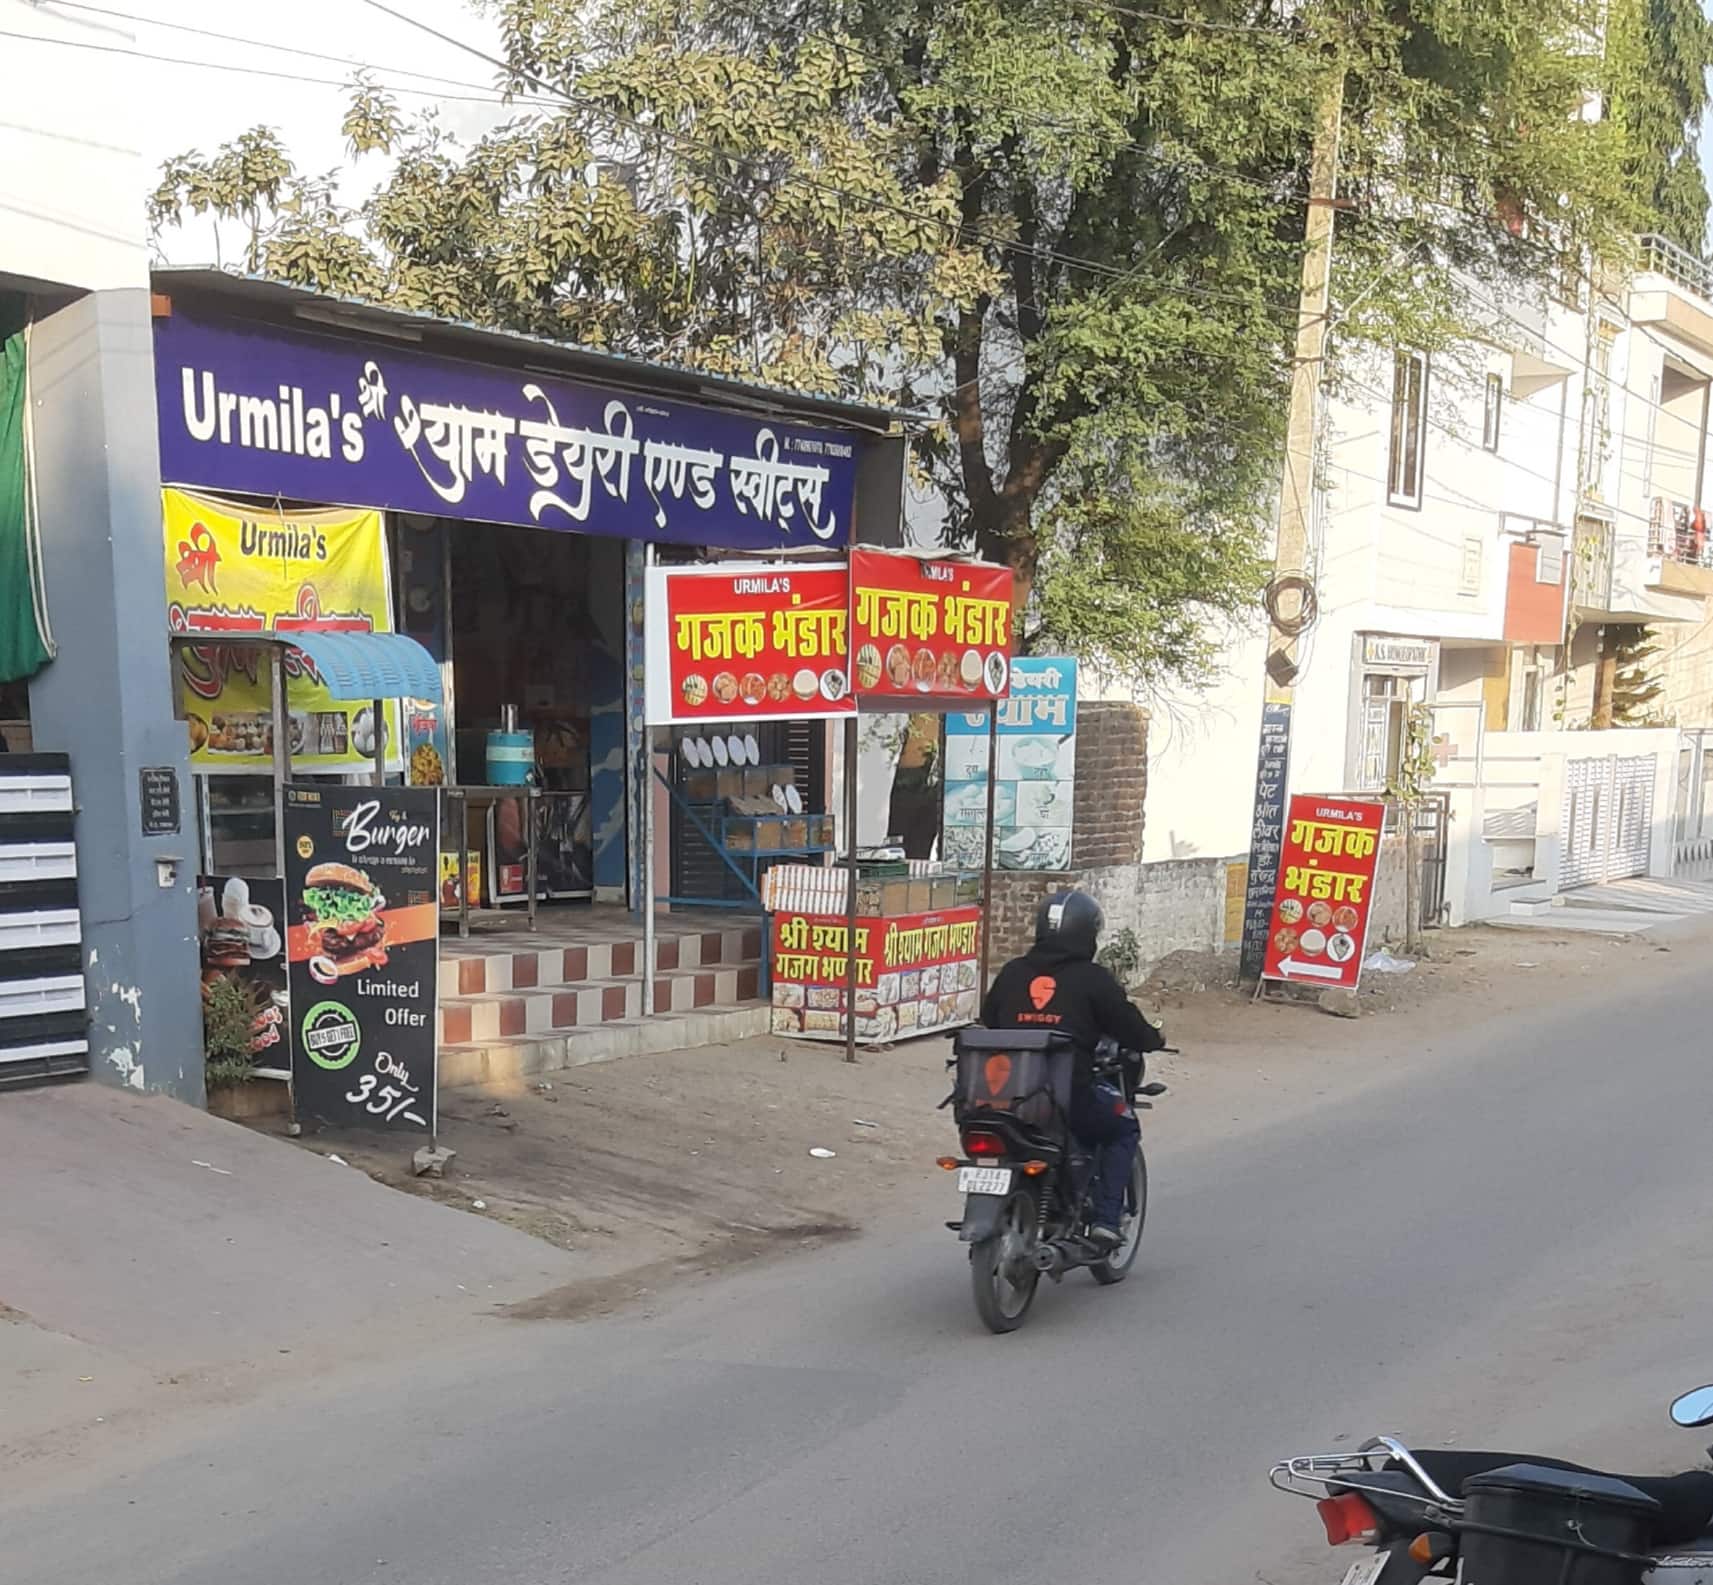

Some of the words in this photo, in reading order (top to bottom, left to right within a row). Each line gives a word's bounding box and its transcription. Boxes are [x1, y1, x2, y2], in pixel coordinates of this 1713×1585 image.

[182, 367, 364, 462] Urmila's
[358, 361, 388, 420] श्री
[394, 395, 515, 503] श्याम
[240, 520, 327, 560] Urmila's
[734, 577, 790, 595] URMILA'S
[675, 611, 766, 660] गजक
[772, 593, 848, 658] भंडार
[855, 586, 939, 641] गजक
[944, 580, 1010, 646] भंडार
[342, 800, 430, 854] Burger
[1316, 807, 1364, 822] URMILA'S
[1291, 820, 1378, 859] गजक
[1284, 859, 1368, 904] भंडार
[780, 916, 809, 950] श्री
[884, 921, 899, 968] श्री
[898, 929, 924, 966] श्याम
[357, 979, 419, 998] Limited
[385, 1008, 427, 1027] Offer
[375, 1052, 419, 1092] Only
[346, 1074, 427, 1126] 35/-
